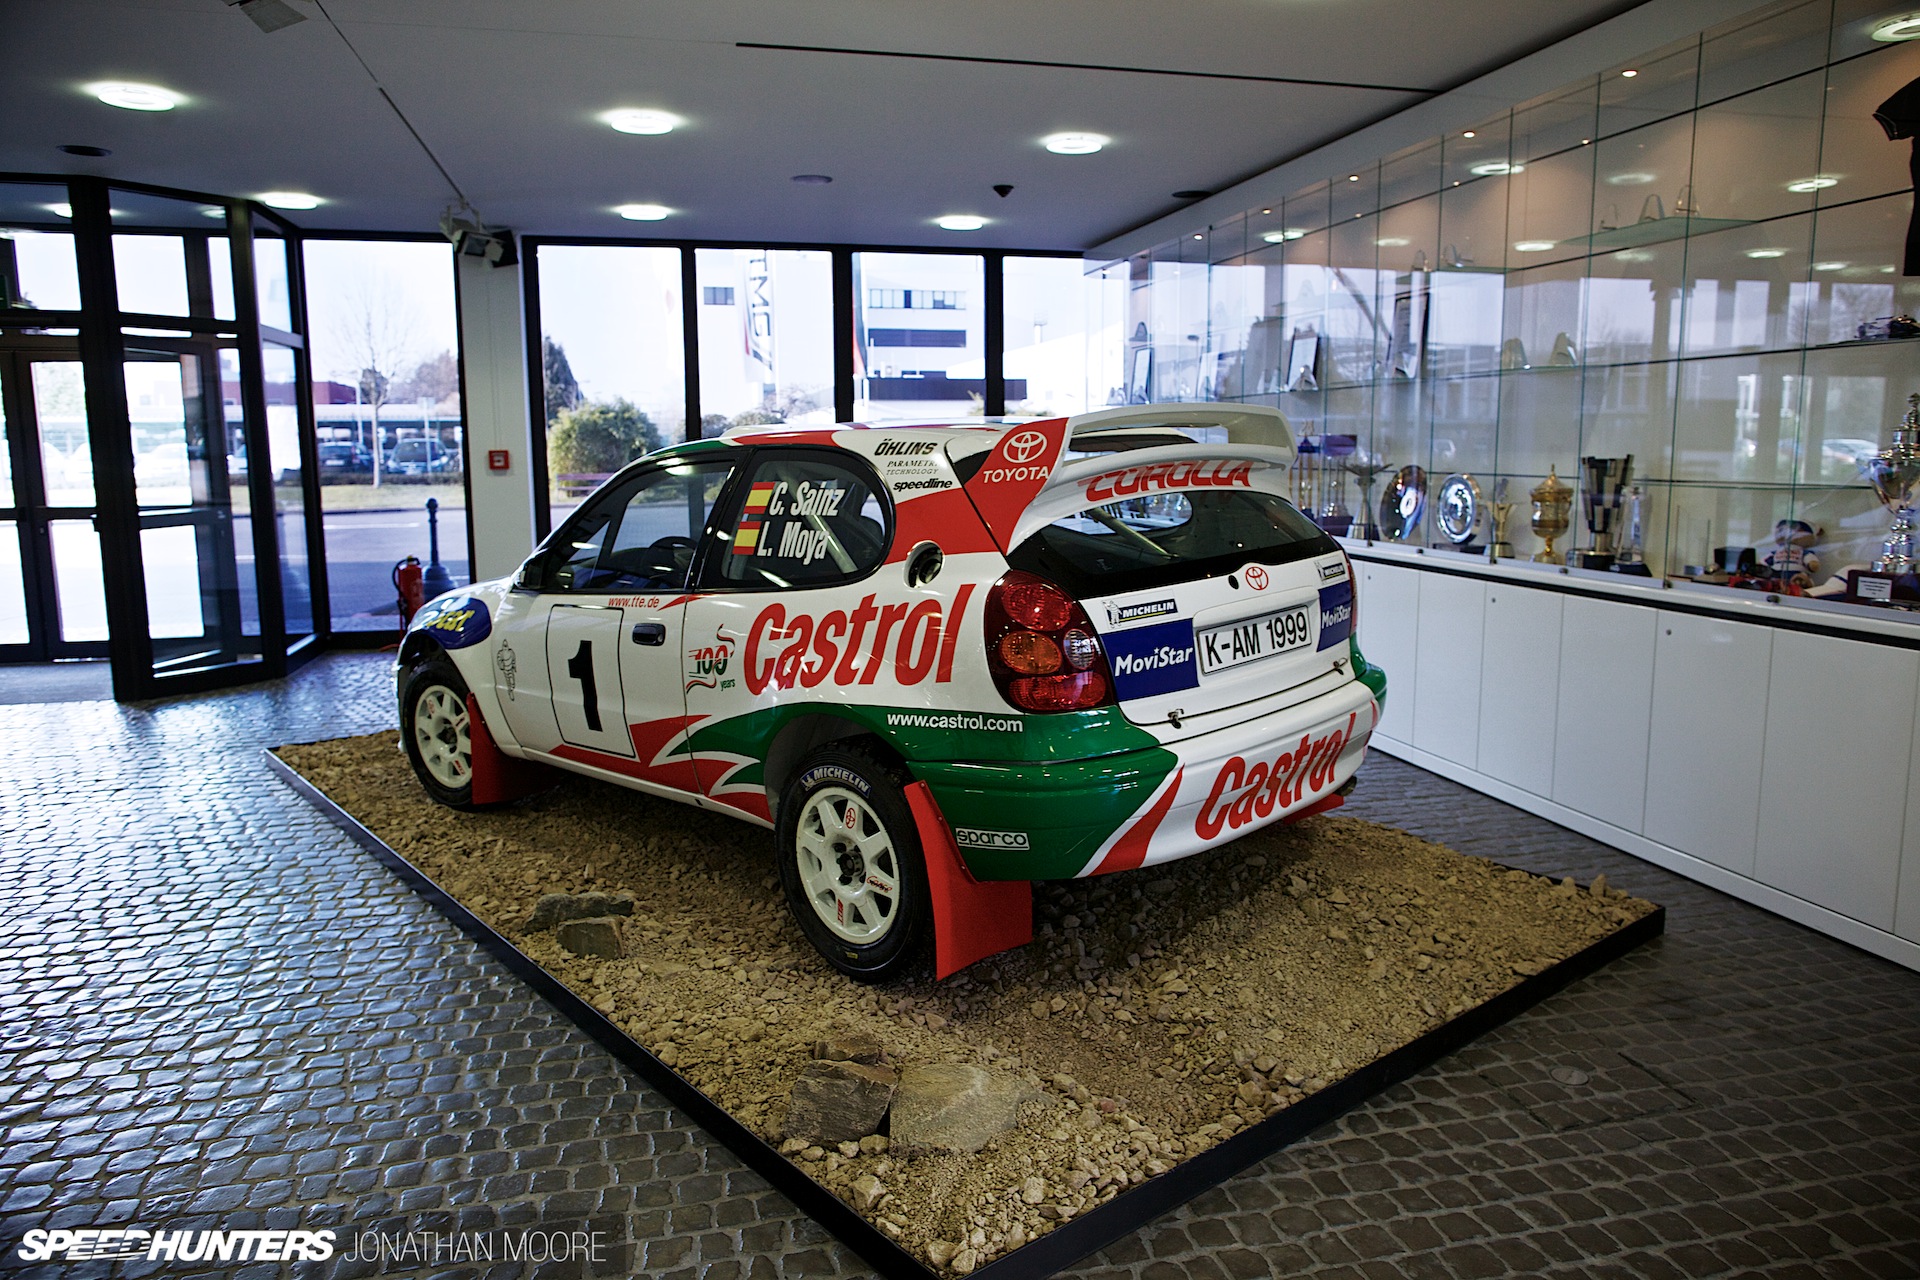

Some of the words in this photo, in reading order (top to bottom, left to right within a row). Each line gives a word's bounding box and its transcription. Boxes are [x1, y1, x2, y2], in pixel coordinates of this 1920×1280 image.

[748, 249, 770, 337] TMG
[874, 438, 938, 456] ÖHLINS
[885, 468, 939, 476] TECHNOLOGY
[886, 460, 938, 468] PARAMETR
[983, 466, 1050, 484] TOYOTA
[893, 478, 953, 492] speedline
[1077, 459, 1252, 502] COROLLA
[769, 481, 788, 516] C.
[790, 481, 846, 516] Sainz
[757, 521, 773, 557] L.
[778, 521, 830, 566] Moya
[608, 596, 660, 608] www.tte.de
[1122, 601, 1175, 619] MICHELIN
[1321, 605, 1351, 630] MoviStar
[744, 584, 977, 696] Castrol
[1205, 622, 1261, 668] K-AM
[1266, 611, 1308, 651] 1999
[692, 644, 729, 676] 100
[1114, 646, 1194, 678] MoviStar
[567, 639, 604, 733] 1
[720, 679, 736, 692] years
[887, 713, 1024, 733] www.castrol.com
[813, 766, 870, 794] MICHELIN
[1195, 712, 1357, 841] Castrol
[957, 828, 1028, 847] sparco
